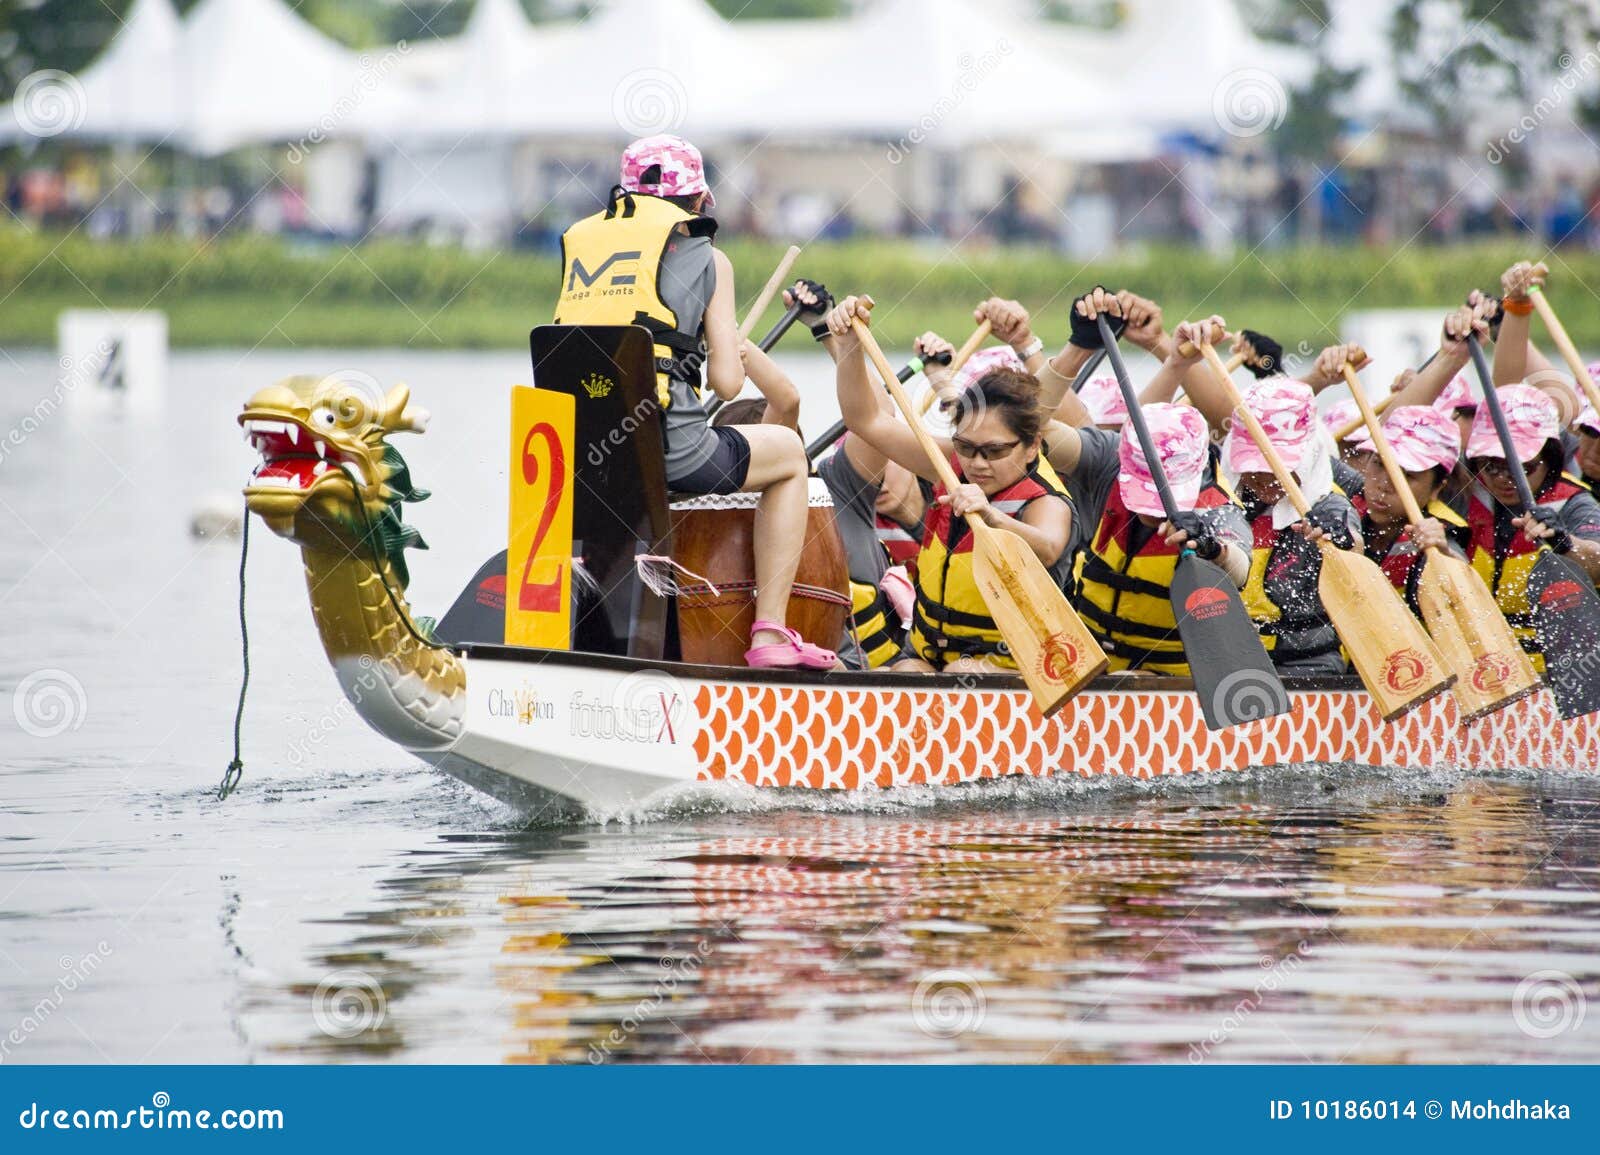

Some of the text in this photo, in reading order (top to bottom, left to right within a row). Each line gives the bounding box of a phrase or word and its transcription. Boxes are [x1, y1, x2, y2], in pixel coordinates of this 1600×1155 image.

[566, 287, 634, 301] ega vents
[518, 422, 565, 614] 2
